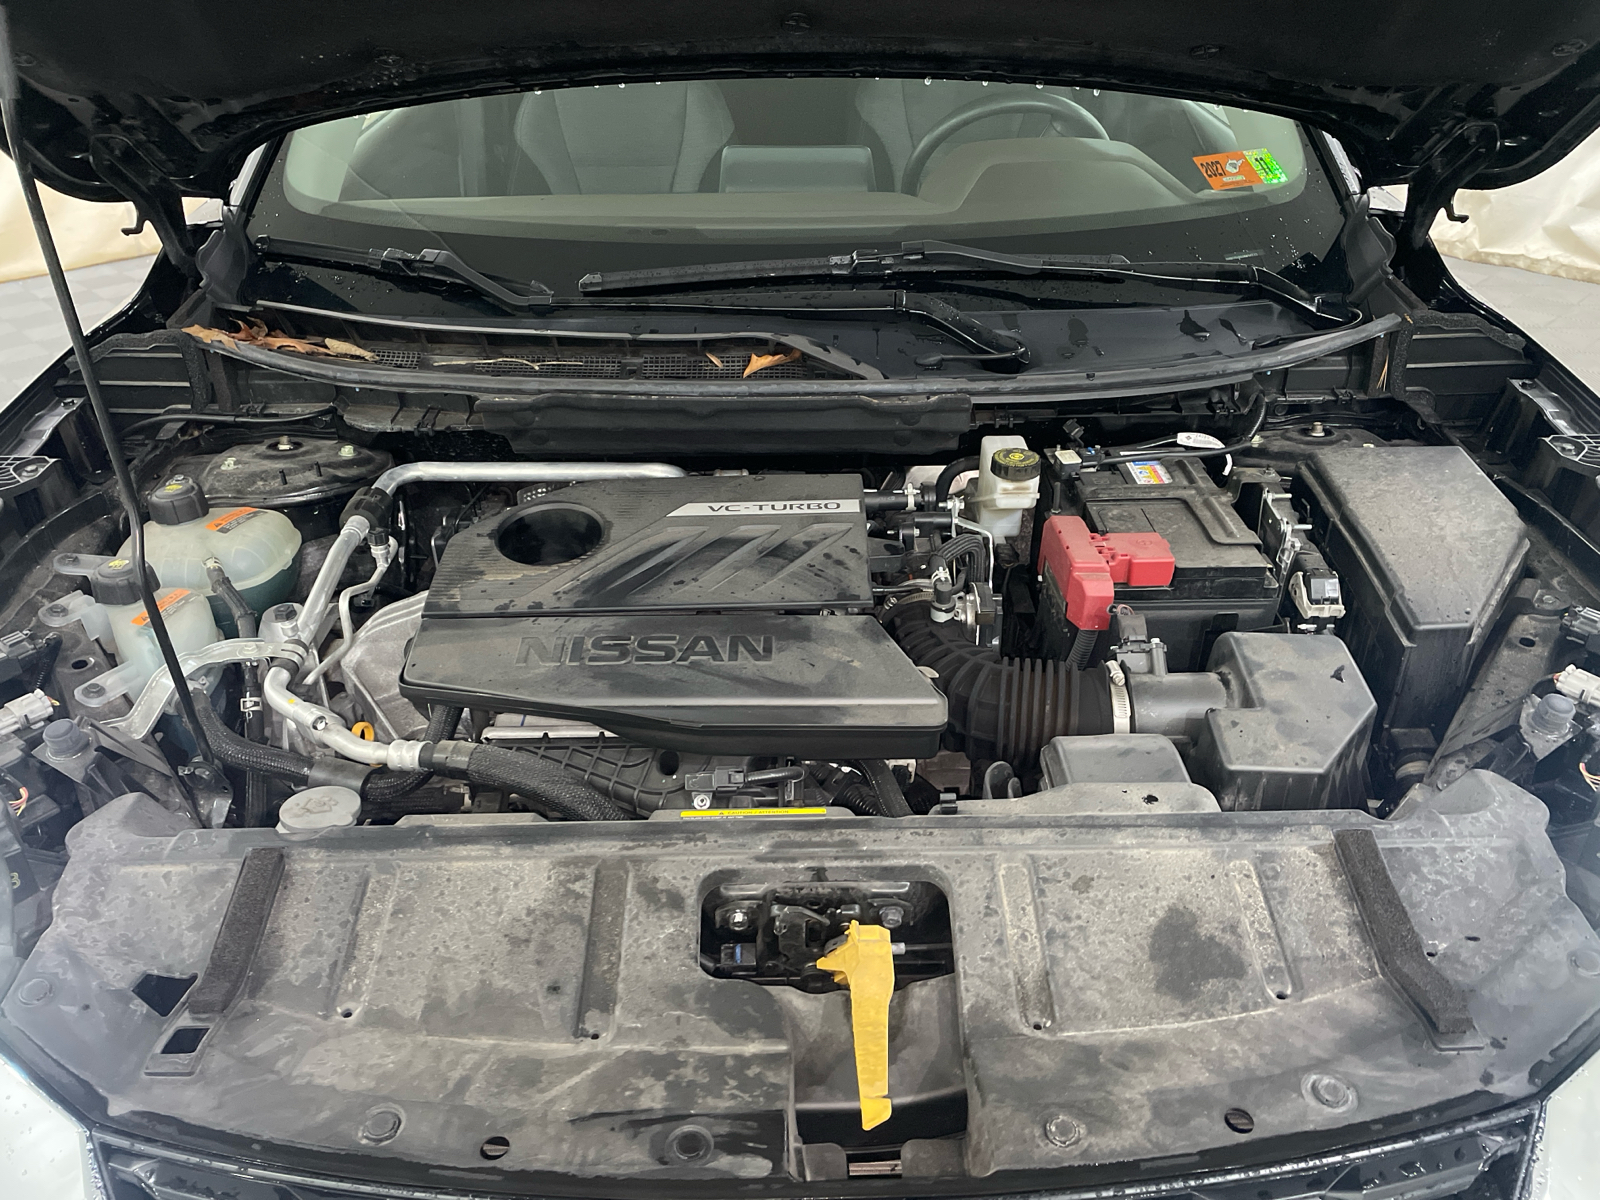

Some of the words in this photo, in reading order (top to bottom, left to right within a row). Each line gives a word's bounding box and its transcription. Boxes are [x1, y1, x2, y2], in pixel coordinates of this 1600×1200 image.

[1200, 160, 1227, 178] 2027
[1254, 157, 1273, 175] 11
[708, 502, 841, 512] VC-TURBO
[515, 634, 776, 666] NISSAN
